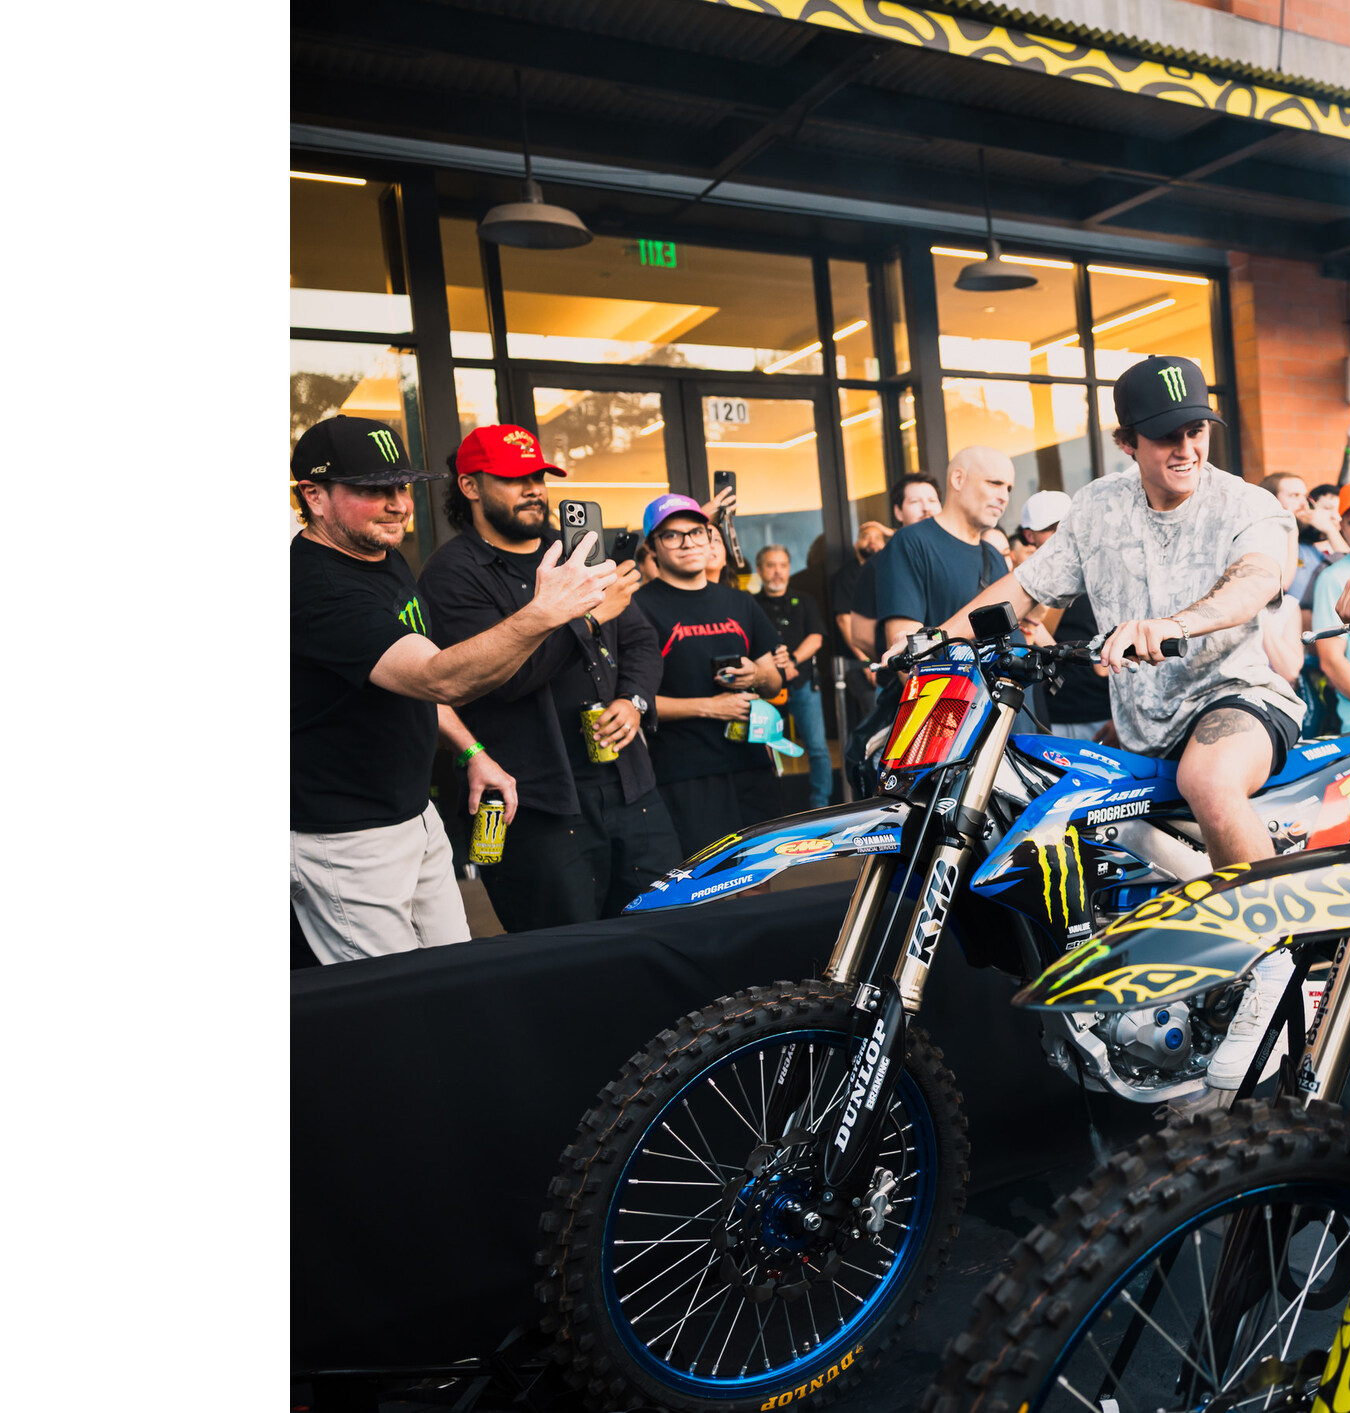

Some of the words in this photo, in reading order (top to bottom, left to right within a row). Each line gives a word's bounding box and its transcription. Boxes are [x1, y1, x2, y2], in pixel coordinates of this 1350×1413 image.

[712, 402, 747, 421] 120
[885, 676, 953, 761] 1
[1087, 800, 1152, 826] PROGRESSIVE
[862, 834, 896, 845] YAMAHA
[691, 874, 754, 901] PROGRESSIVE
[906, 857, 959, 969] KYB
[778, 1043, 796, 1085] CYCRA
[834, 1018, 886, 1154] DUNLOP
[865, 1056, 890, 1111] BRAKING
[761, 1350, 855, 1412] DUNLOP
